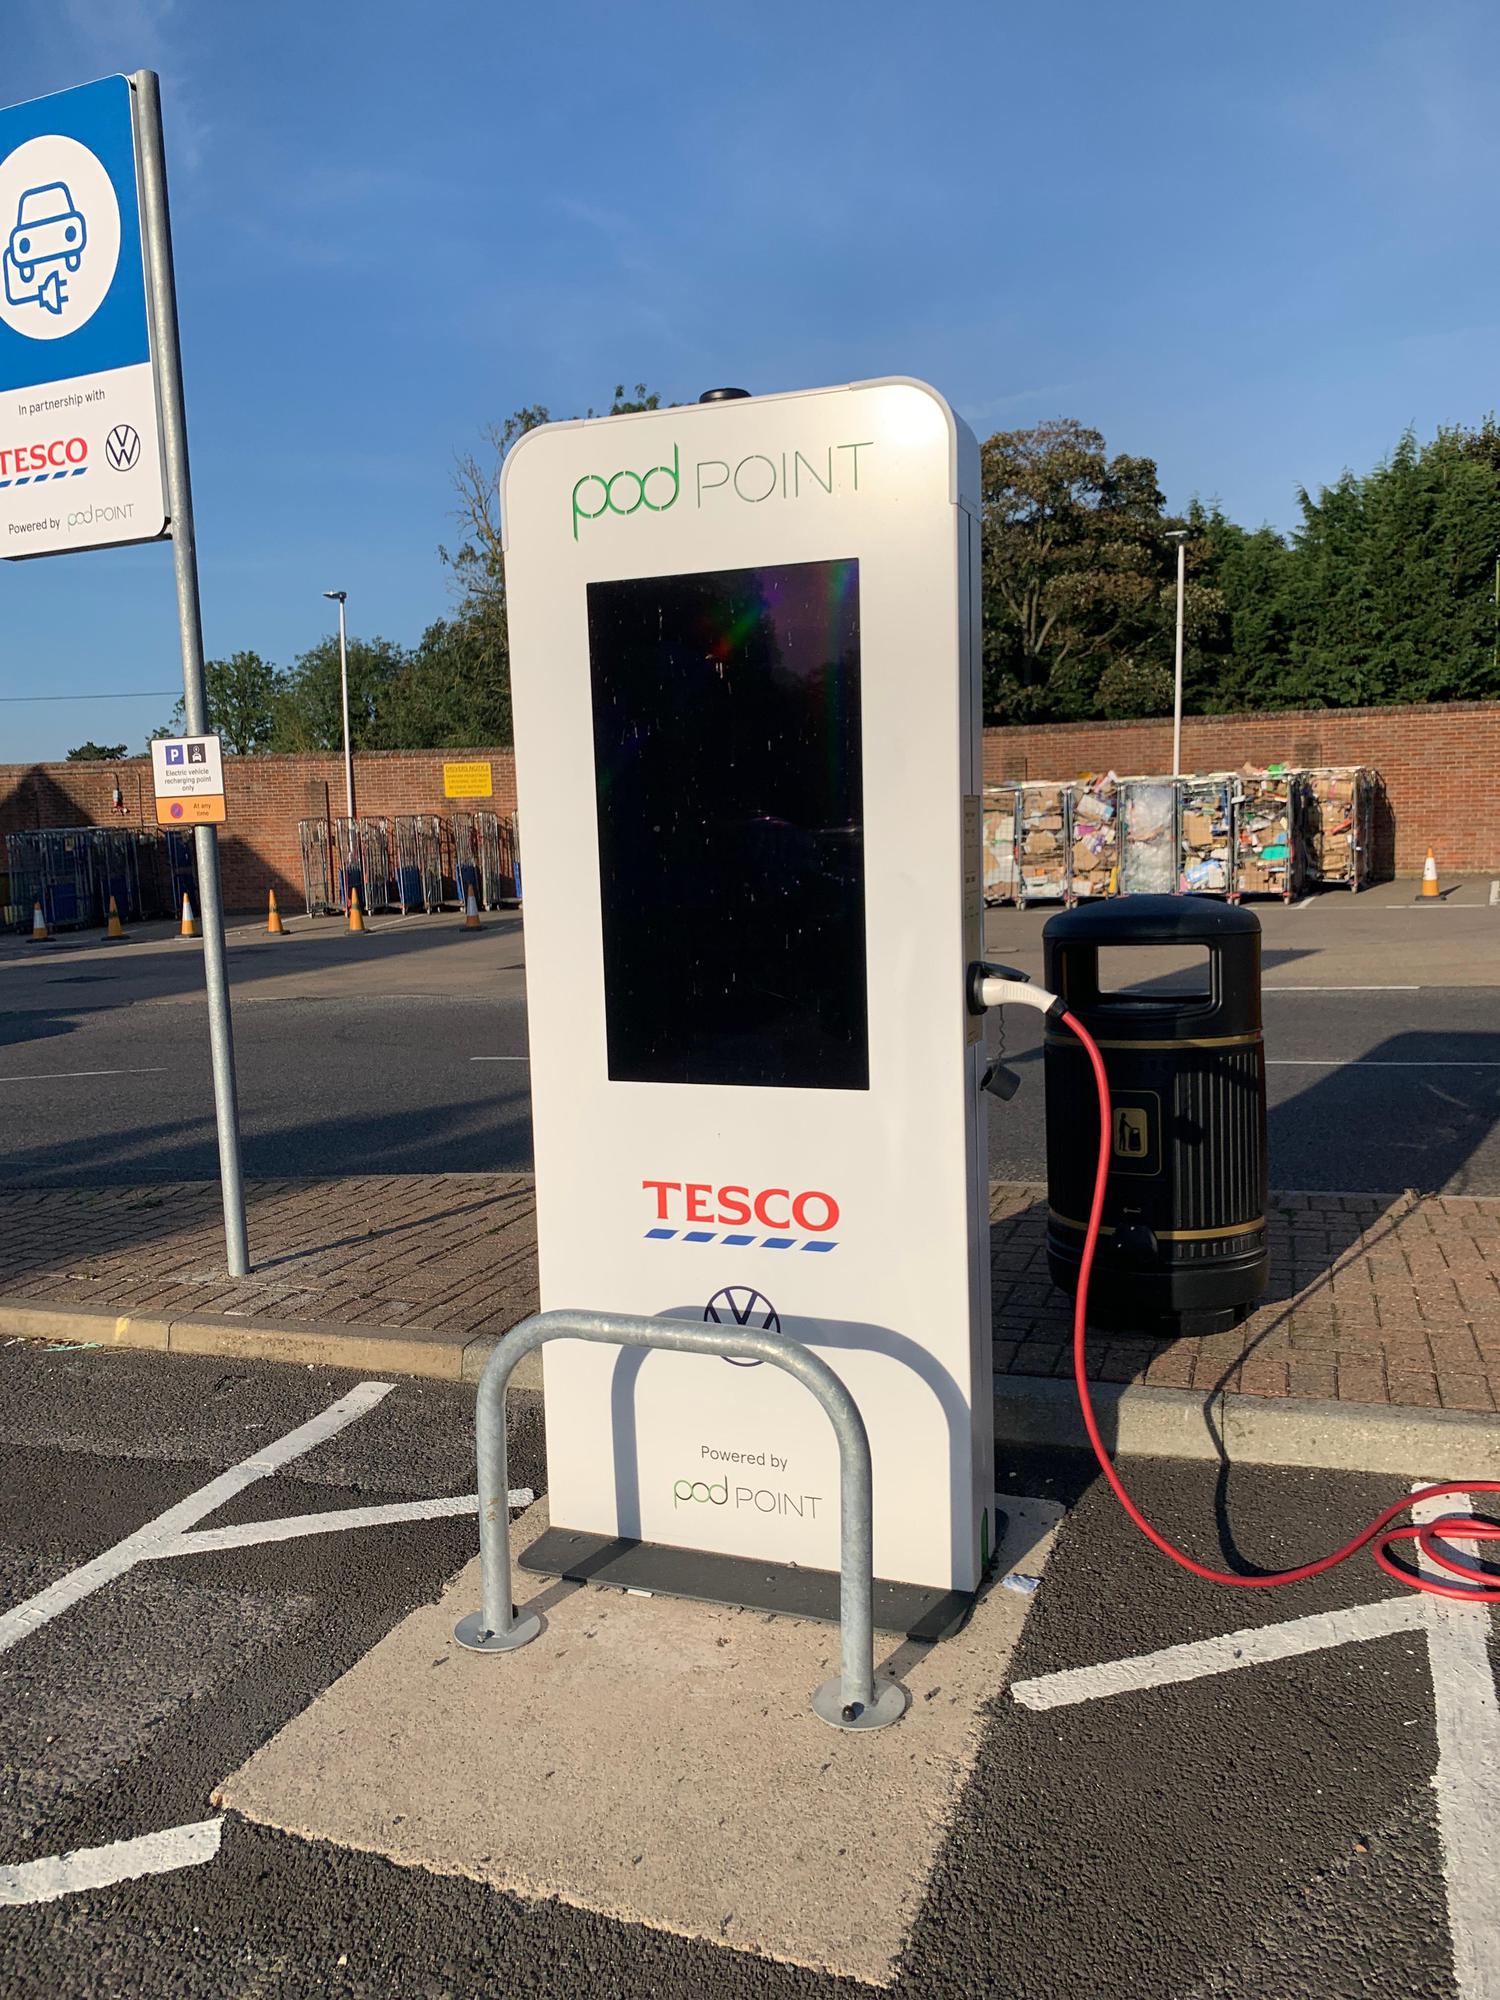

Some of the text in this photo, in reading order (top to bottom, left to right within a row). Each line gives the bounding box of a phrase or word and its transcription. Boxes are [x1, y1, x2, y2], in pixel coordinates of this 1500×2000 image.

[18, 389, 106, 417] In partnership with
[0, 437, 89, 476] TESCO
[571, 441, 874, 543] pod POINT
[8, 503, 135, 535] Powered by pod POINT
[164, 777, 196, 785] recharging
[165, 768, 209, 777] Electric vehicle
[642, 1180, 840, 1232] TESCO
[701, 1445, 788, 1472] Powered by
[673, 1474, 823, 1519] pod POINT
